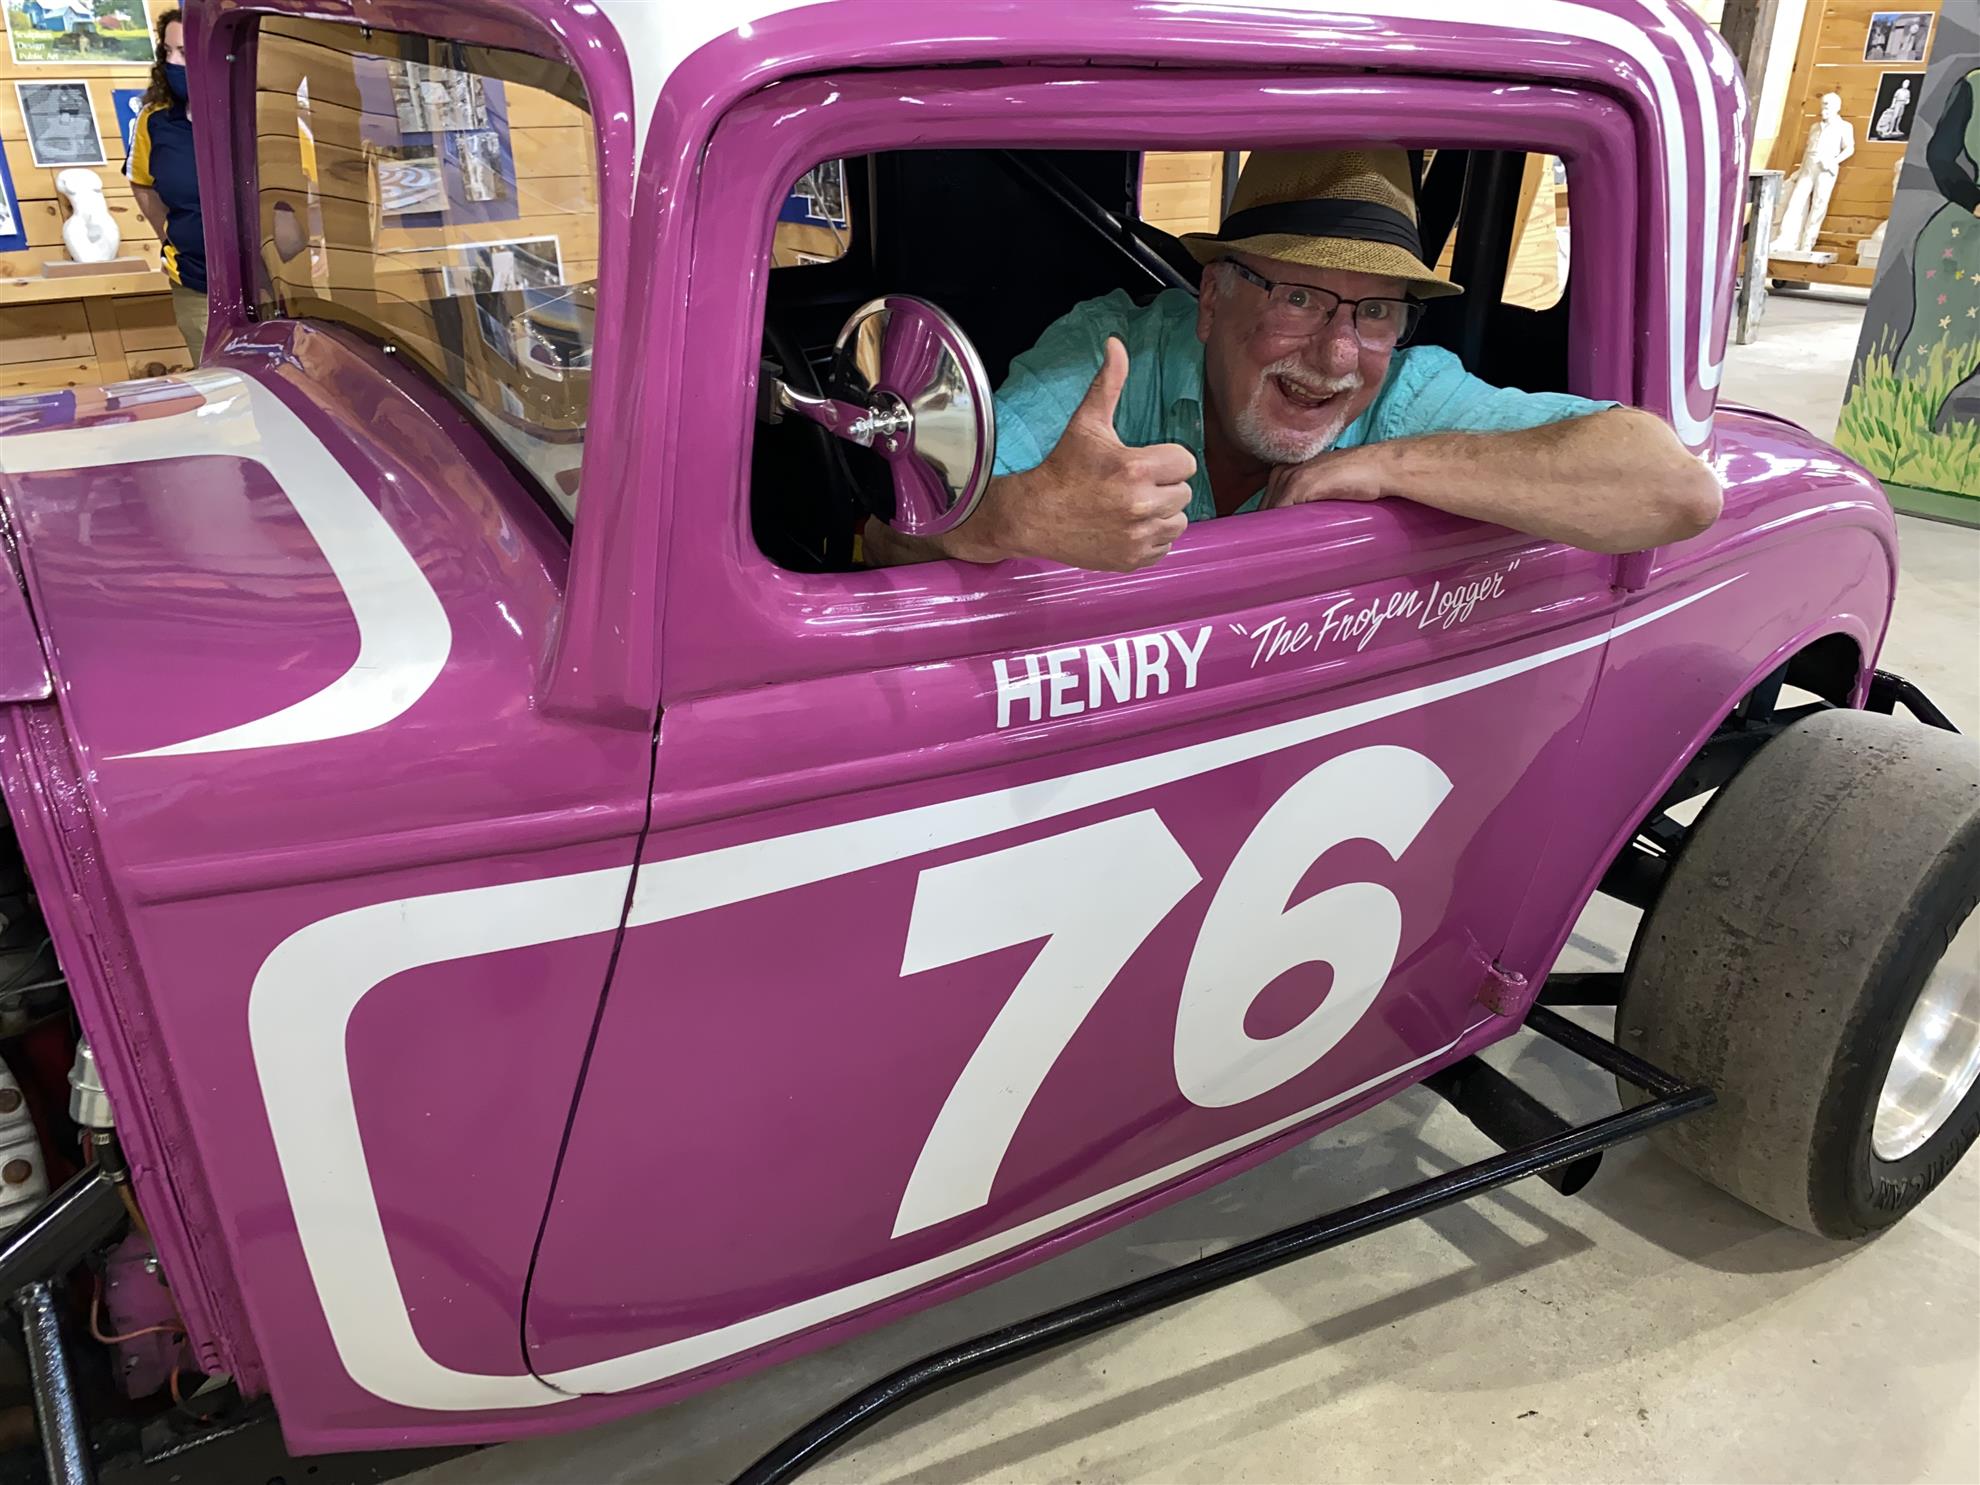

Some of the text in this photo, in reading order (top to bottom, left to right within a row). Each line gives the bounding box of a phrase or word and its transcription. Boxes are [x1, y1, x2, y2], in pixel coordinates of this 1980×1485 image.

[992, 625, 1213, 729] HENRY
[1313, 590, 1423, 652] Frozen
[890, 744, 1455, 1240] 76
